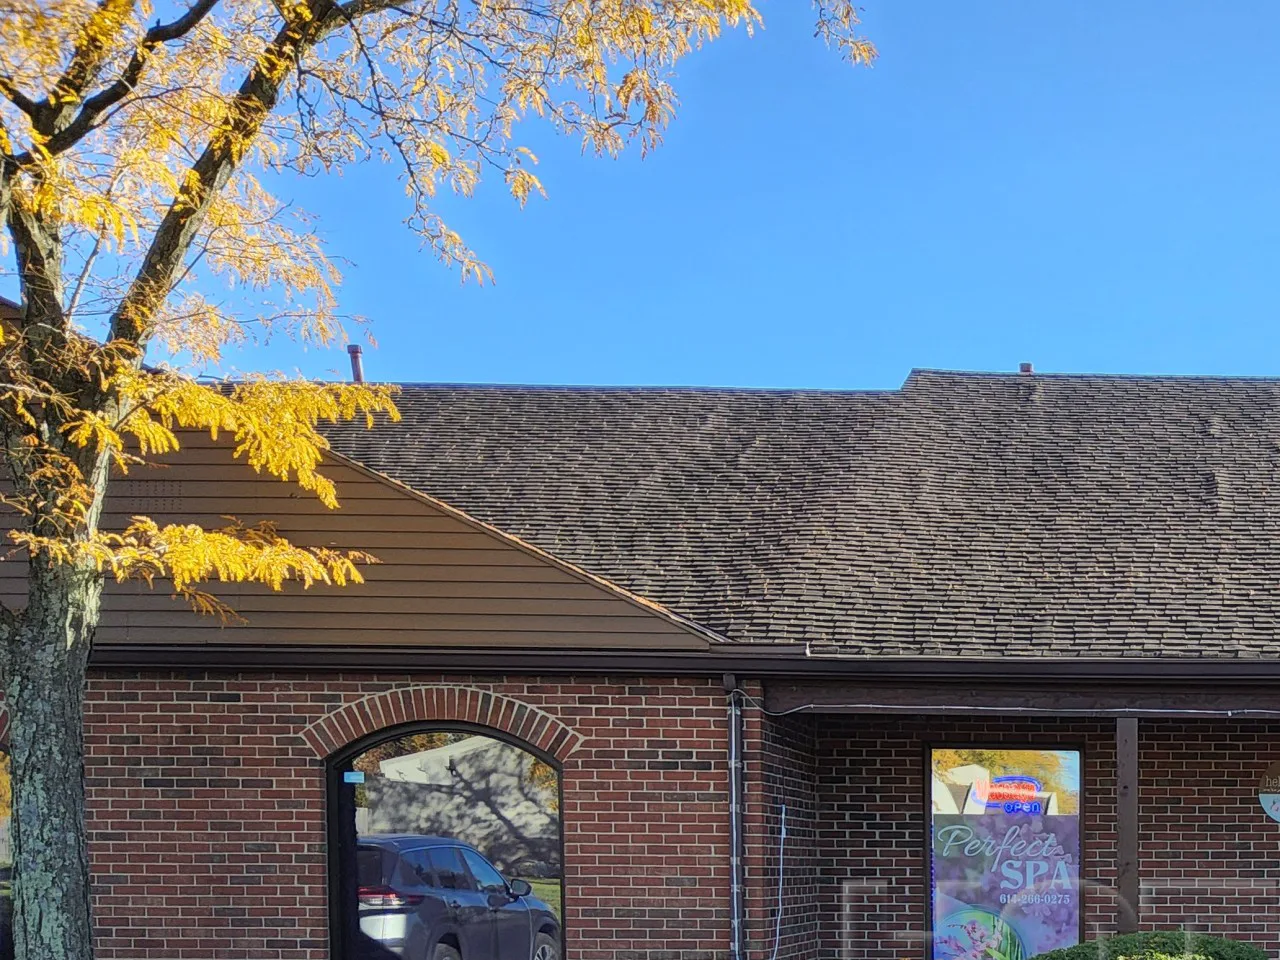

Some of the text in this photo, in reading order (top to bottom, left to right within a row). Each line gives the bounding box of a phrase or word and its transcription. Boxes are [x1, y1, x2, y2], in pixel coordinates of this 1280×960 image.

[937, 825, 1063, 872] Perfect
[1000, 860, 1072, 890] SPA
[999, 893, 1070, 905] 614-266-0275
